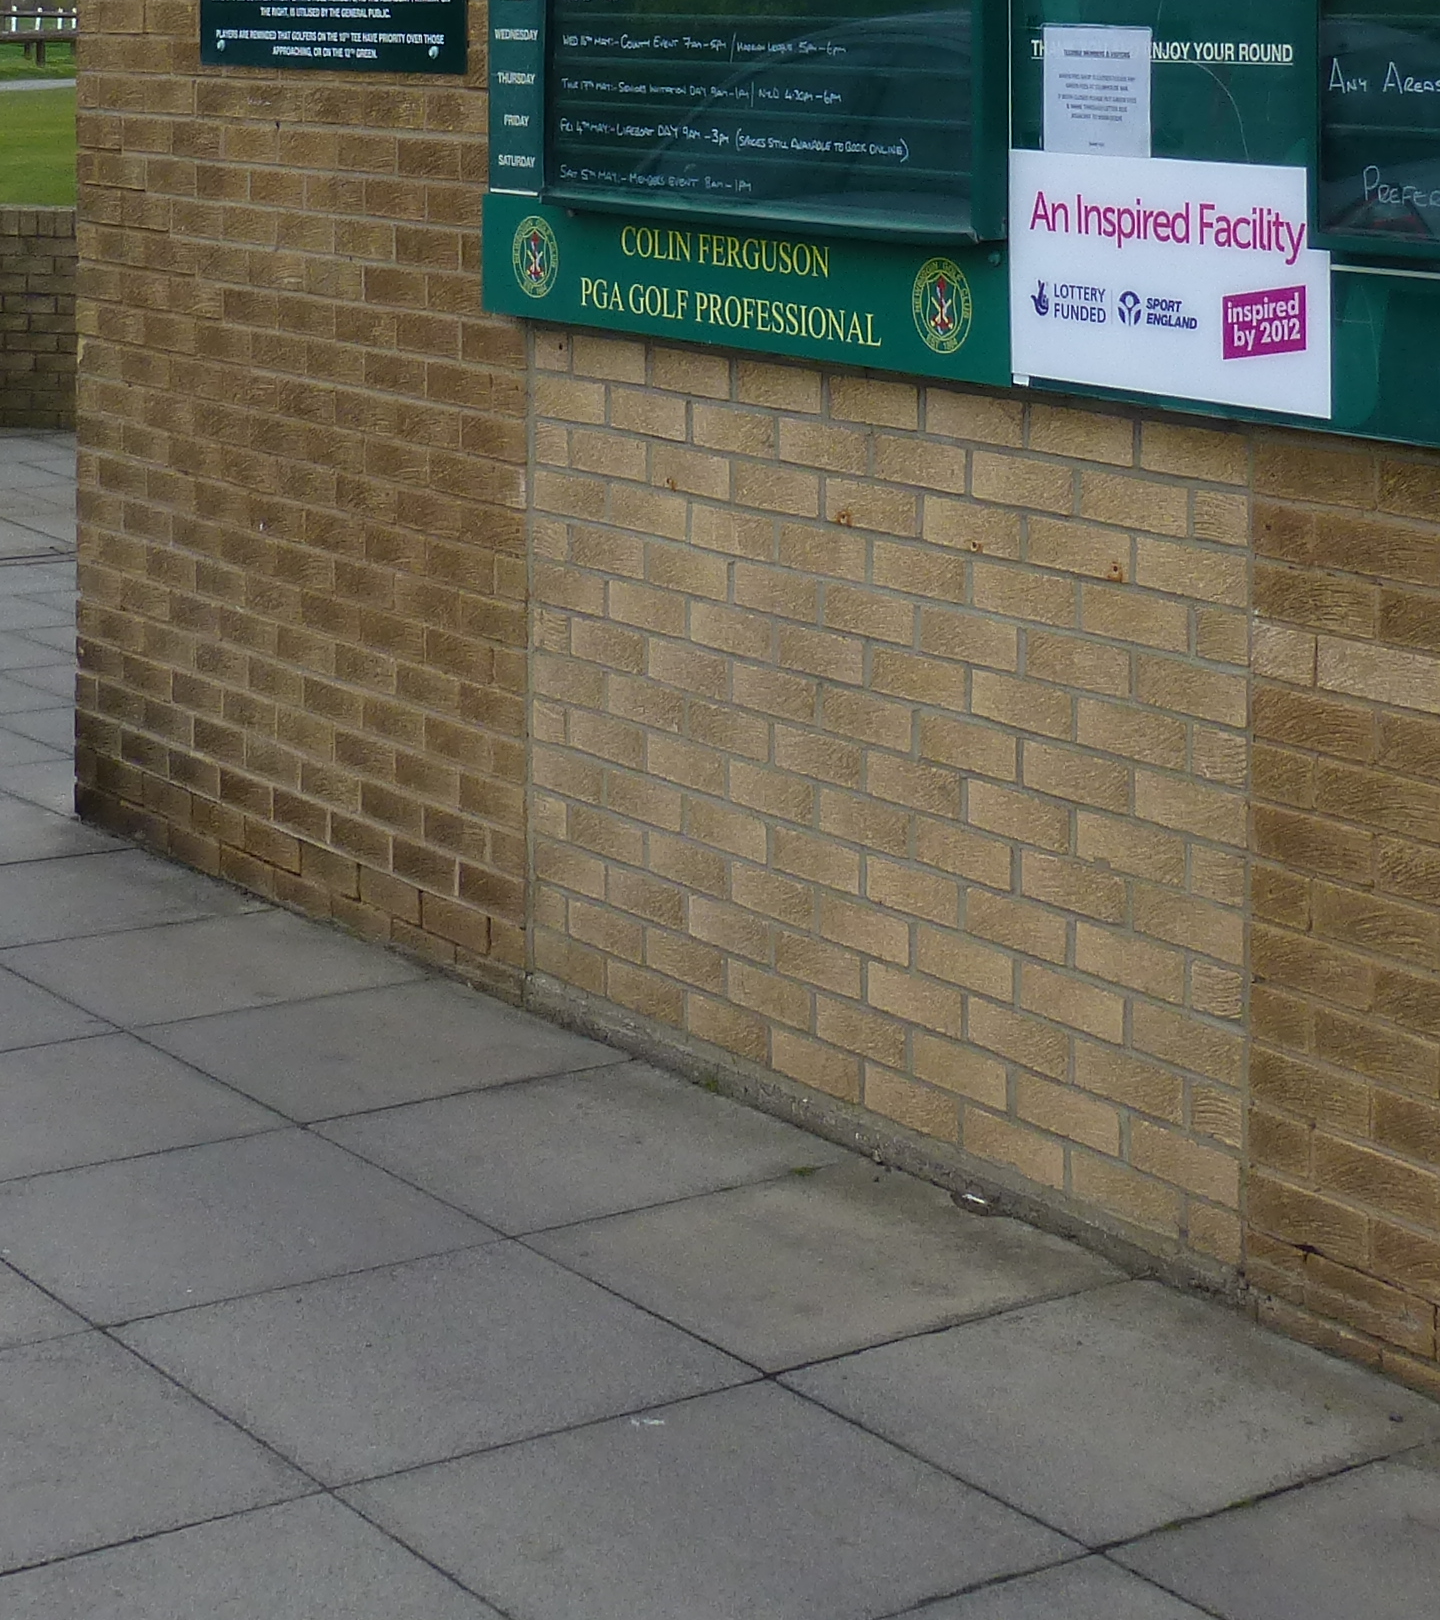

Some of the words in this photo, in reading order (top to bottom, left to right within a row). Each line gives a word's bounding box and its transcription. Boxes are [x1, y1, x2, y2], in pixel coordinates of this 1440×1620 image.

[1194, 42, 1234, 61] YOUR
[1239, 44, 1292, 62] ROUND
[1030, 191, 1069, 232] An
[1077, 194, 1190, 248] Inspired
[1199, 203, 1305, 265] Facility
[621, 225, 691, 262] COLIN
[699, 235, 829, 277] FERGUSON
[1054, 284, 1106, 302] LOTTERY
[1146, 297, 1182, 312] SPORT
[580, 277, 624, 311] PGA
[629, 284, 688, 320] GOLF
[694, 294, 881, 347] PROFESSIONAL
[1054, 303, 1106, 323] FUNDED
[1228, 293, 1299, 324] inspired
[1146, 313, 1197, 330] ENGLAND
[1234, 327, 1254, 350] by
[1260, 319, 1300, 343] 2012
